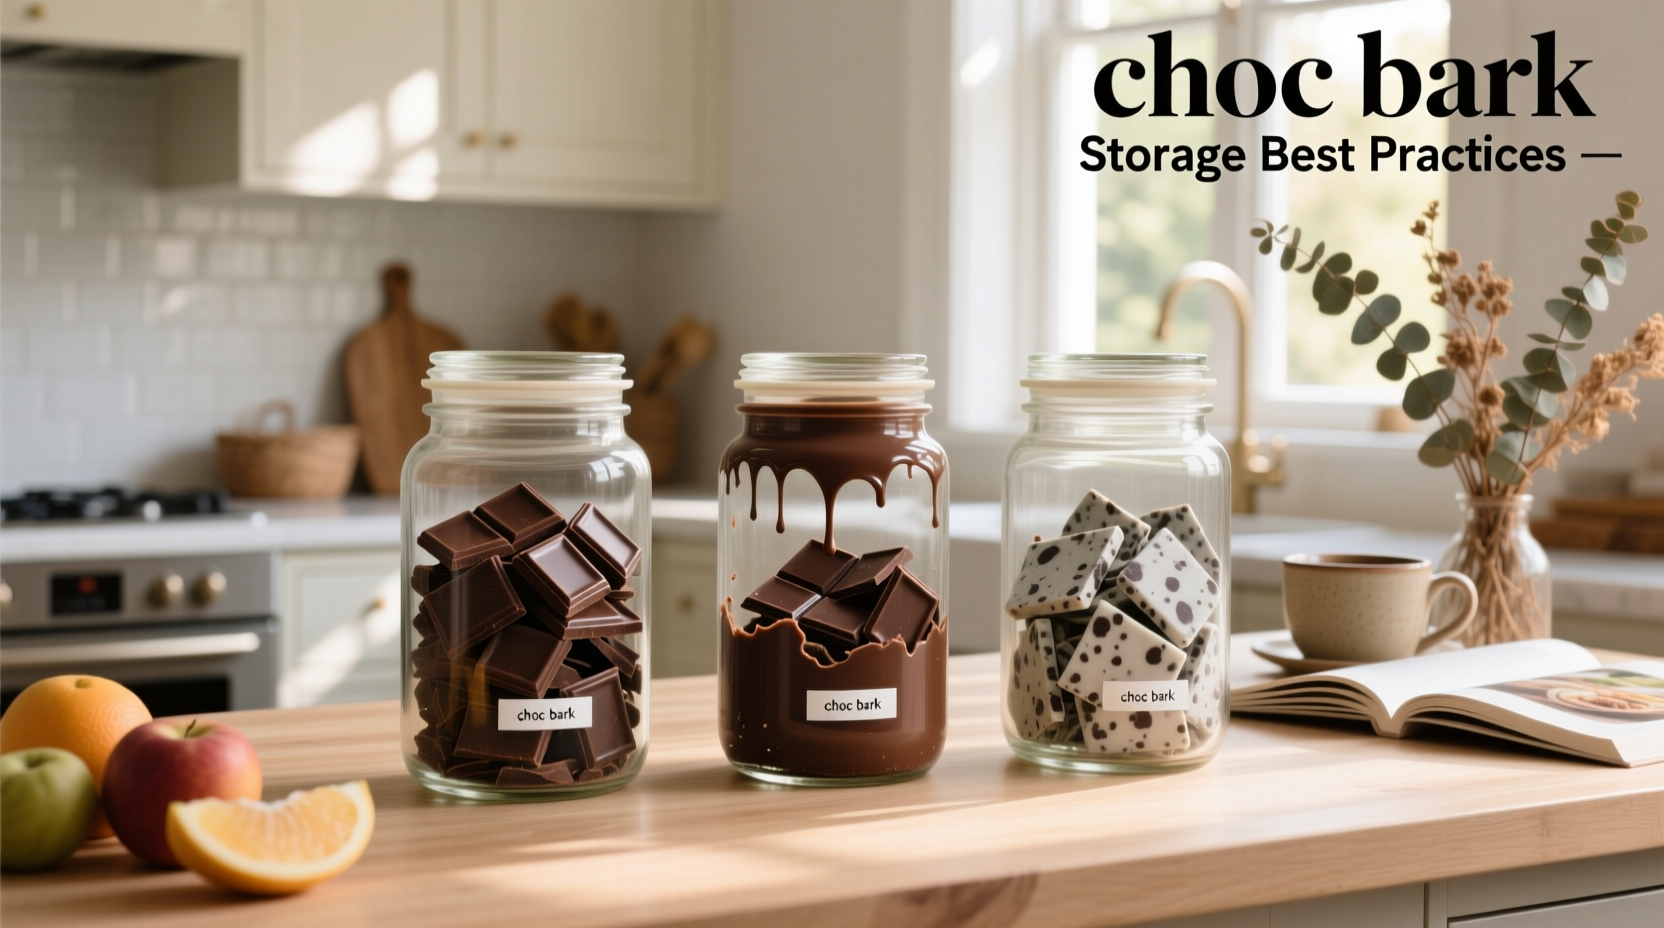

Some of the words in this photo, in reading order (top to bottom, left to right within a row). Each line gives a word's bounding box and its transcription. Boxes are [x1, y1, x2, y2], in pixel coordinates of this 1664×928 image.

[1120, 690, 1148, 703] choc
[1151, 689, 1175, 702] bark
[824, 699, 853, 712] choc
[856, 697, 881, 711] bark
[517, 708, 545, 721] choc
[549, 707, 575, 720] bark
